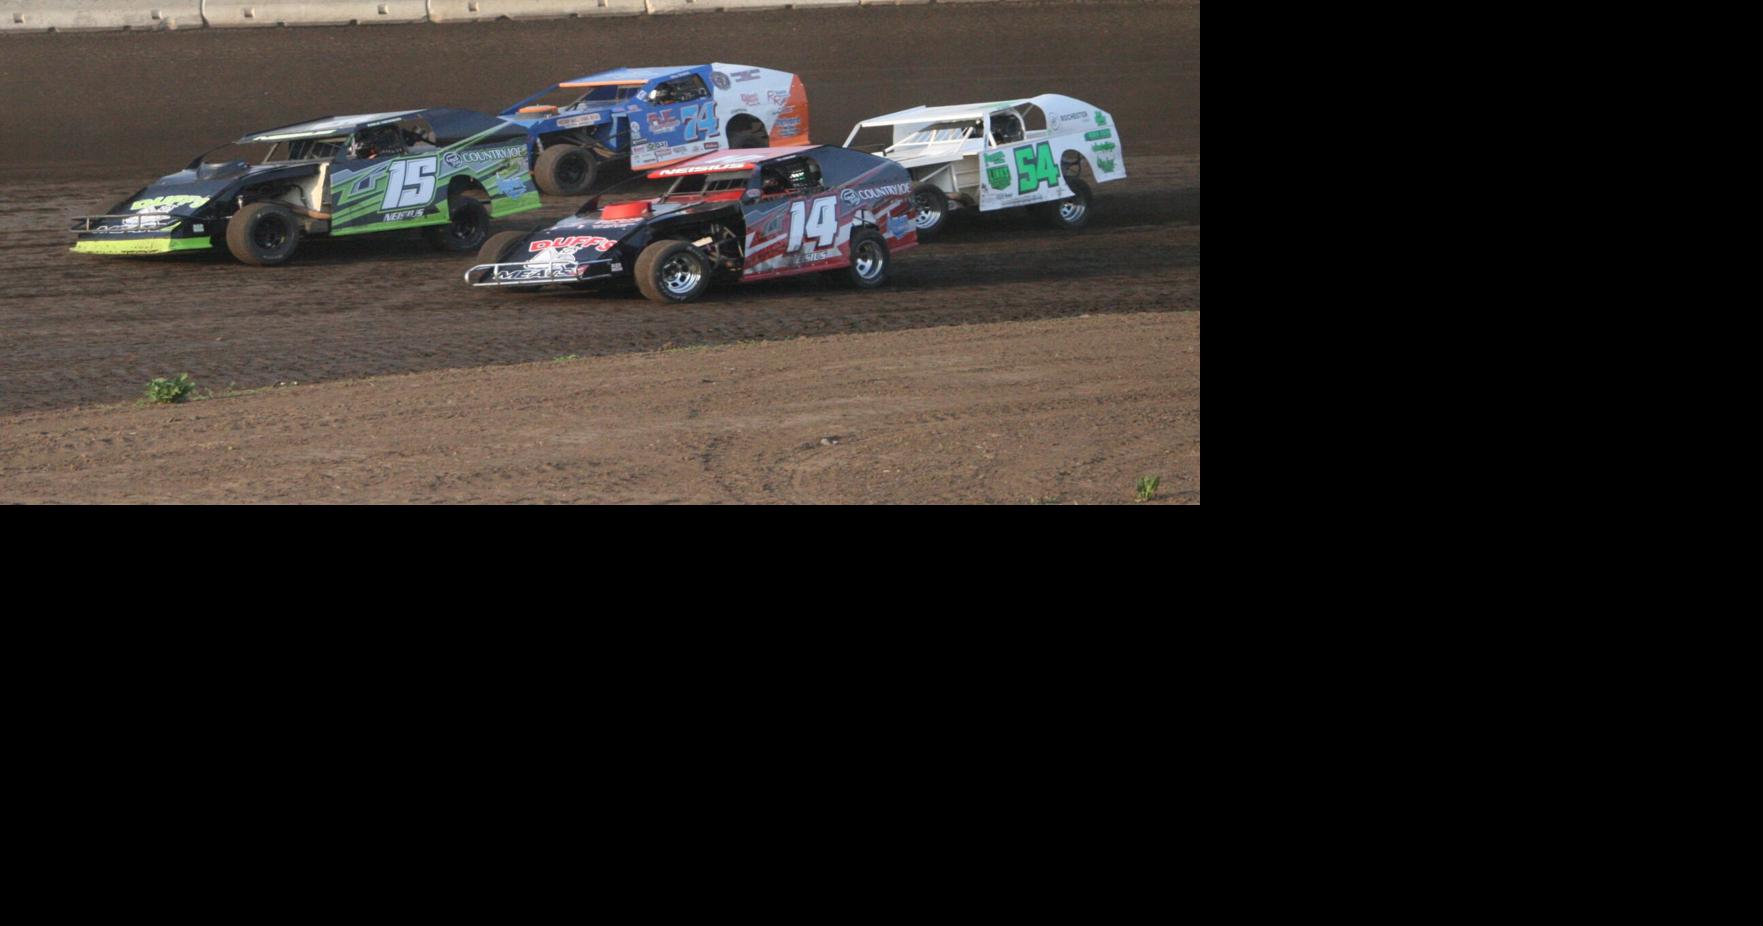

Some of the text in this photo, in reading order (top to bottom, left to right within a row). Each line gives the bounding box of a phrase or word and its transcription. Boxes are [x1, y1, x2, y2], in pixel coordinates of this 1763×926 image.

[682, 101, 720, 141] 74
[463, 149, 506, 162] COUNTRY
[660, 163, 745, 175] NEISIUS
[1013, 141, 1060, 195] 54
[382, 157, 437, 209] 15
[859, 184, 896, 199] COUNTRY
[897, 182, 912, 195] JOE
[786, 195, 838, 253] 14
